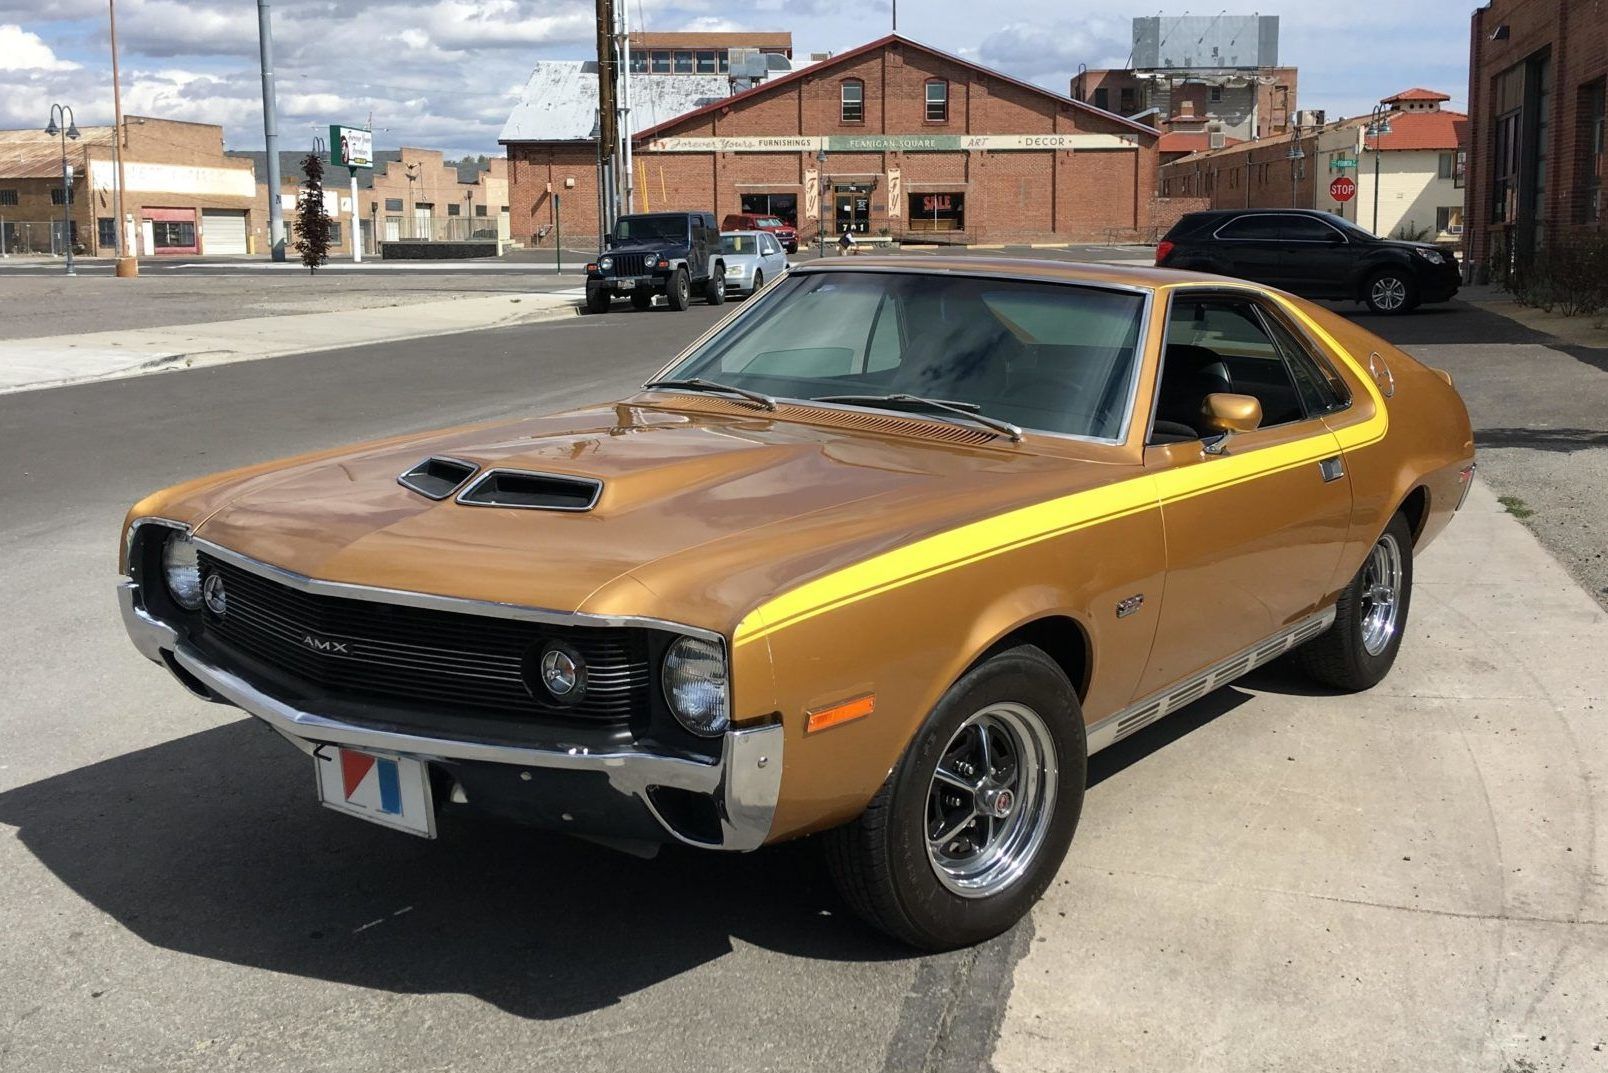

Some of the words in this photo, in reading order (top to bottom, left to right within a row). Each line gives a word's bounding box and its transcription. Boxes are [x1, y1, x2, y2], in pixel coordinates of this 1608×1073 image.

[849, 140, 896, 148] FLANIGAN
[967, 138, 989, 147] ART
[1025, 138, 1065, 146] DECOR
[1331, 184, 1354, 194] STOP
[923, 195, 952, 210] SALE
[303, 636, 348, 653] AMX
